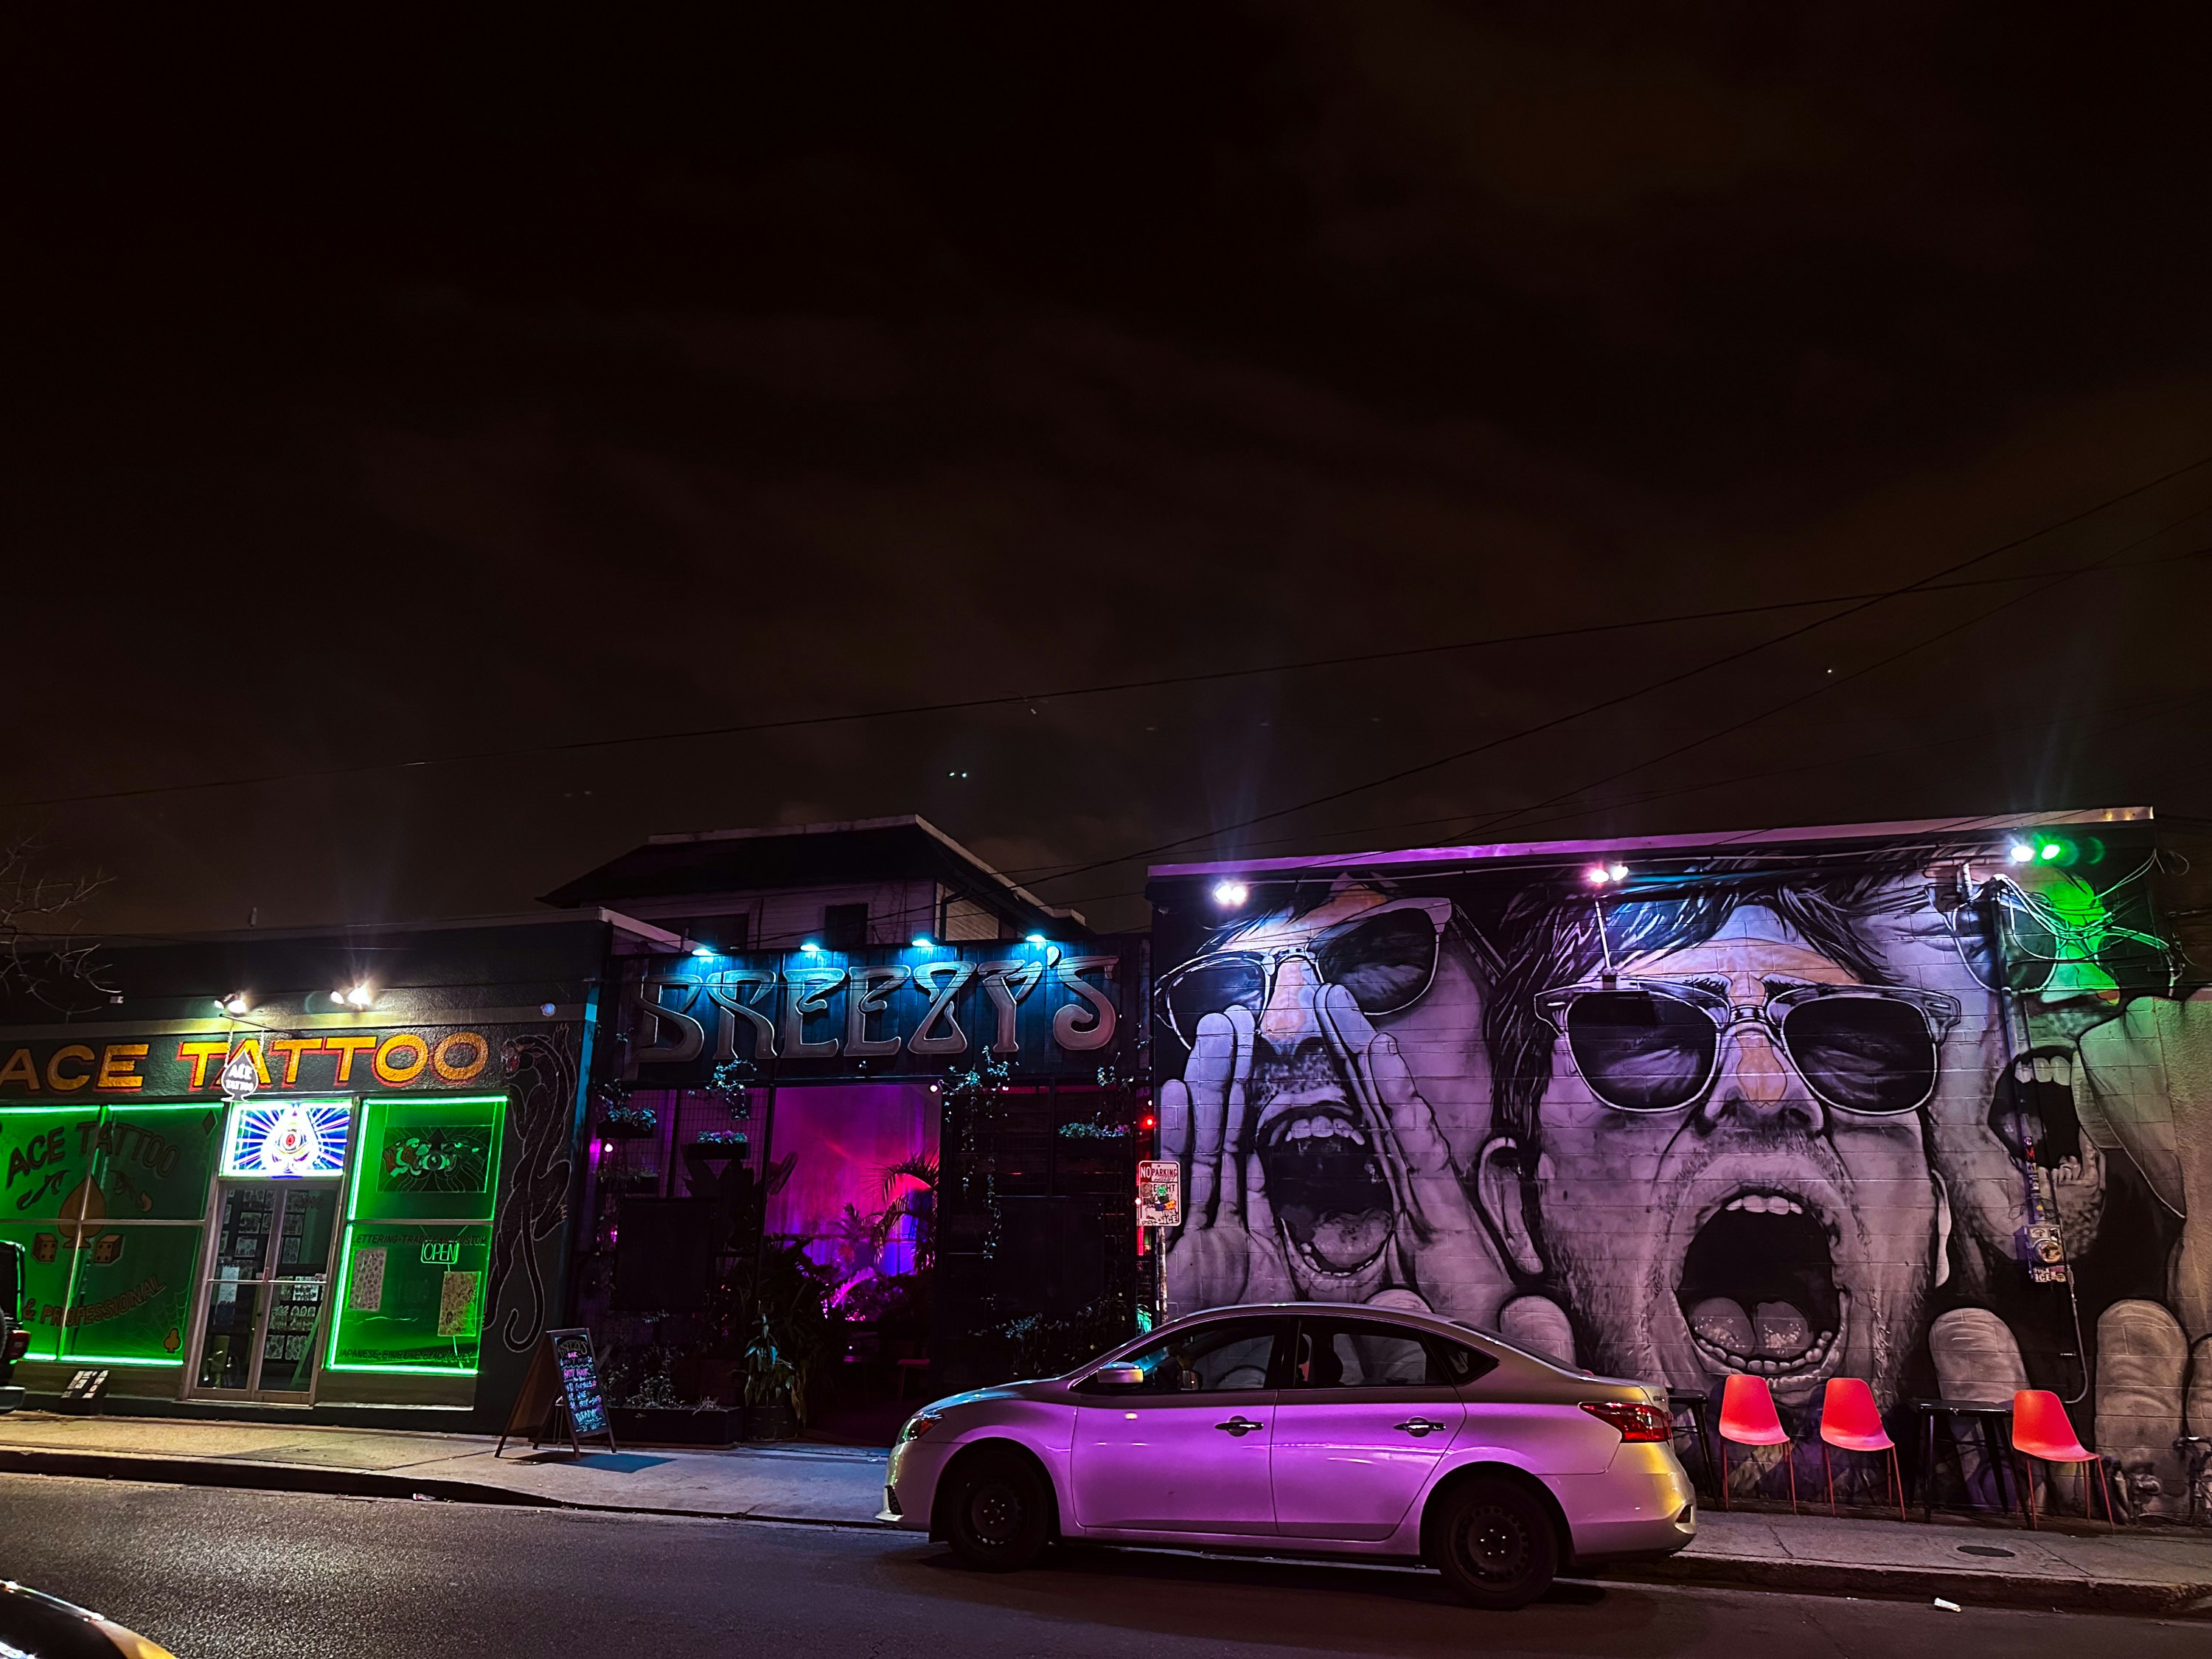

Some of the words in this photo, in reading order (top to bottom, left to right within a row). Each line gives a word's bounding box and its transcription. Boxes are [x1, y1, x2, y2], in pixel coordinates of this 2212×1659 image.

[632, 946, 1119, 1062] BREEZY'S
[0, 1045, 150, 1094] ACE
[176, 1034, 488, 1093] TATTOO
[229, 1063, 253, 1079] ACE
[226, 1079, 254, 1091] TATTOO
[6, 1127, 66, 1190] ACE
[76, 1121, 181, 1178] TATTOO
[1141, 1166, 1151, 1178] NO
[1152, 1168, 1178, 1177] PARKING
[1164, 1216, 1178, 1224] ICE
[352, 1234, 398, 1245] LETTERING
[456, 1235, 487, 1245] CUSTOM
[424, 1243, 457, 1261] OPEN
[2035, 1273, 2051, 1281] ICE
[40, 1274, 167, 1327] PROFESSIONAL
[338, 1349, 378, 1360] JAPANESE
